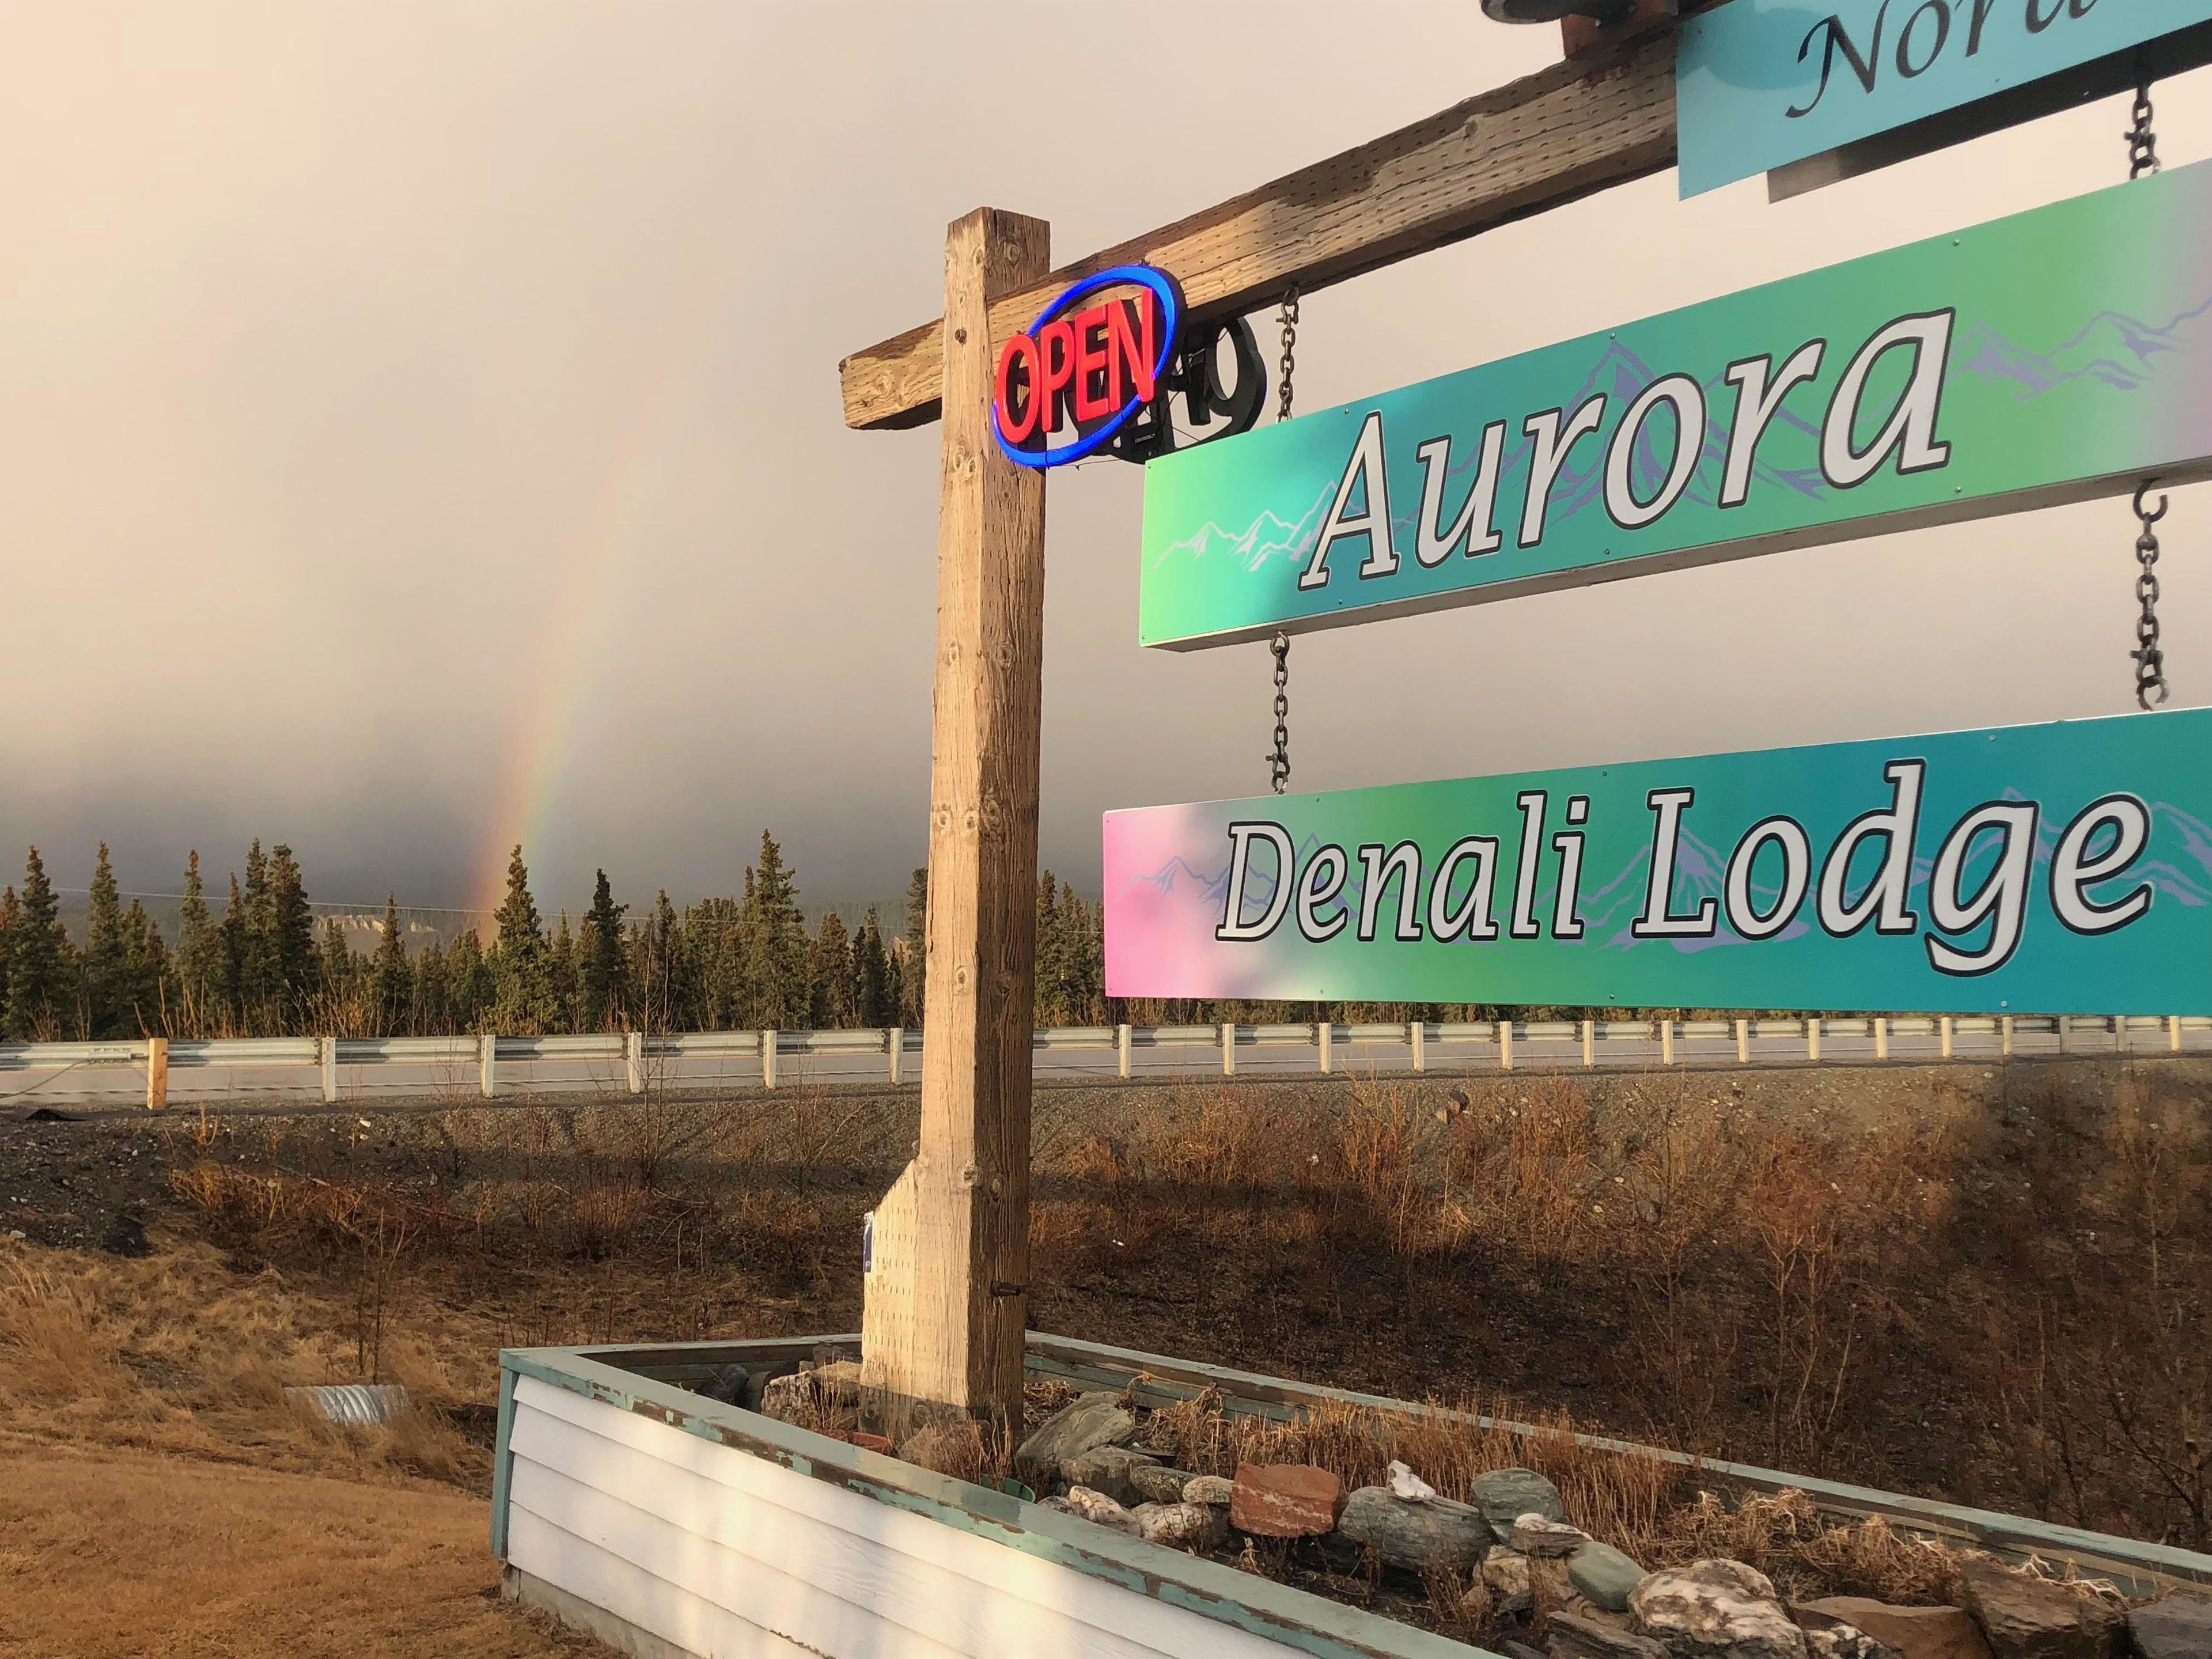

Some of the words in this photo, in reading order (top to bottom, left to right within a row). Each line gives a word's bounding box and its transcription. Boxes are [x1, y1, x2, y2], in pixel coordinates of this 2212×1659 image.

[995, 287, 1154, 443] OPEN
[1297, 306, 1956, 591] Aurora
[1215, 789, 1588, 942] Denali
[1631, 757, 2153, 978] Lodge
